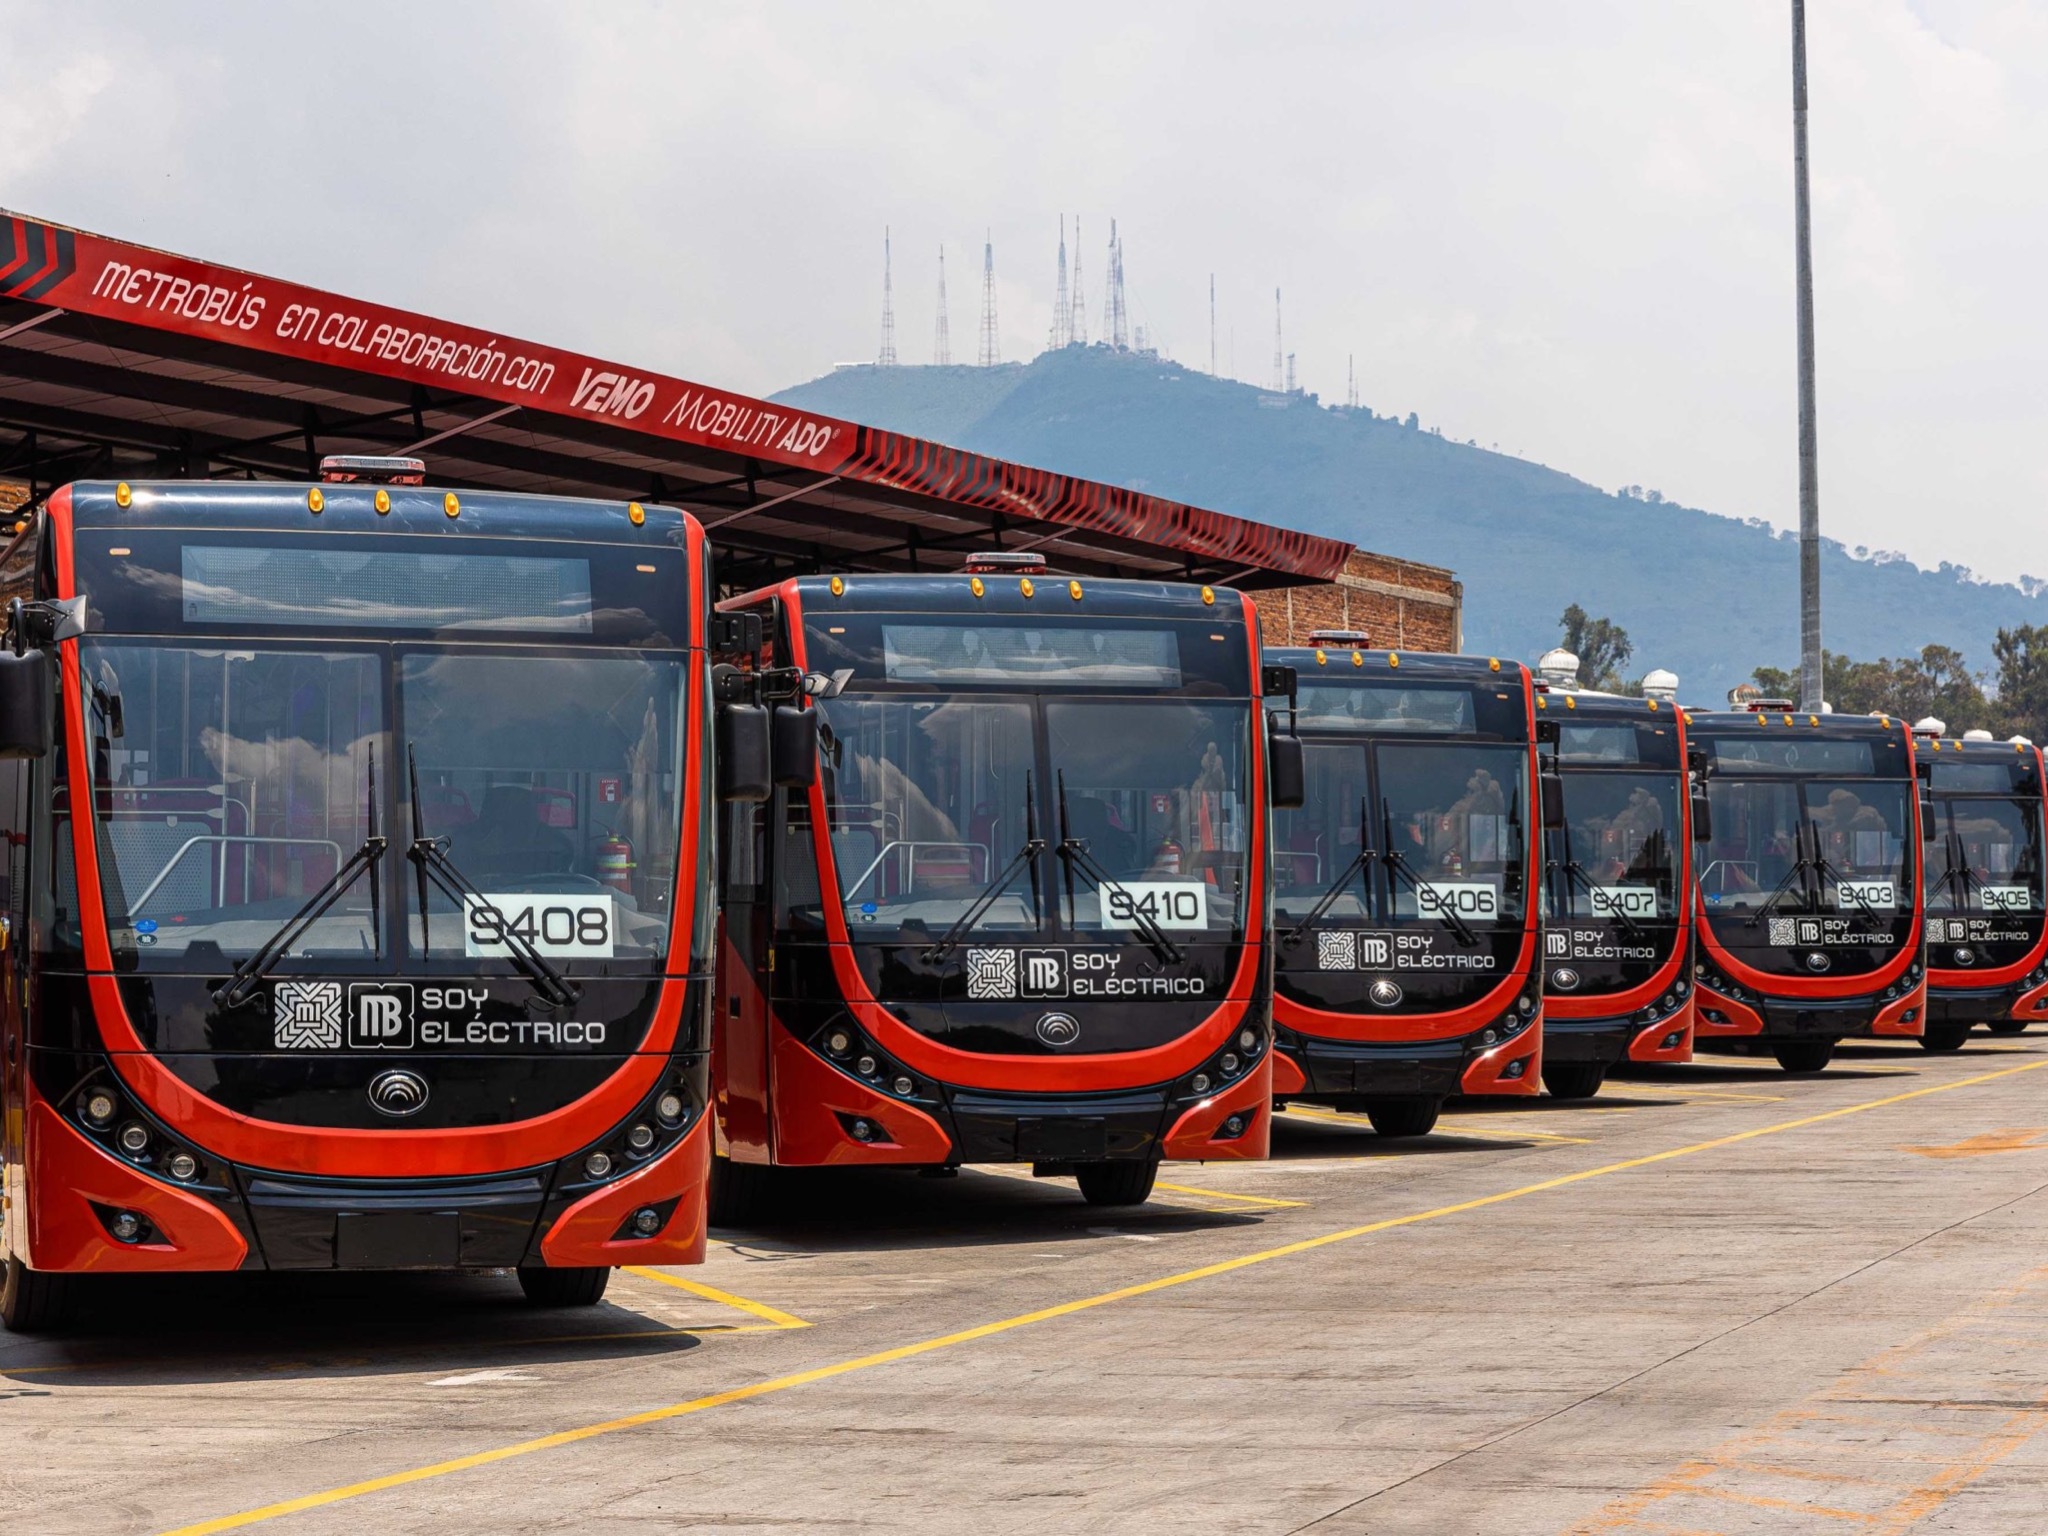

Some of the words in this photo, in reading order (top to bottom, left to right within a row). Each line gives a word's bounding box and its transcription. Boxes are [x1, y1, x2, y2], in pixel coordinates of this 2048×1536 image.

[92, 261, 266, 330] METROBÚS
[318, 312, 506, 383] COLABORACIÓN
[569, 367, 656, 420] VEMO
[1420, 889, 1494, 913] 9406
[1593, 892, 1654, 912] 9407
[1840, 887, 1893, 903] 9403
[1983, 891, 2029, 906] 9405
[1109, 891, 1199, 921] 9410
[470, 905, 608, 945] 9408
[1824, 920, 1850, 930] SOY
[1969, 920, 1991, 929] SOY
[1397, 936, 1433, 949] SOY
[1547, 933, 1567, 954] MB
[1574, 931, 1604, 942] SOY
[1824, 931, 1894, 944] ELÉCTRICO
[1969, 929, 2029, 941] ELÉCTRICO
[1364, 939, 1388, 964] MB
[1397, 950, 1495, 968] ELÉCTRICO
[1574, 943, 1655, 958] ELÉCTRICO
[1072, 953, 1121, 970] SOY
[1028, 957, 1060, 989] MB
[1073, 972, 1205, 995] ELÉCTRICO
[421, 988, 489, 1011] SOY
[361, 994, 402, 1037] MB
[420, 1012, 606, 1044] ELÉCTRICO
